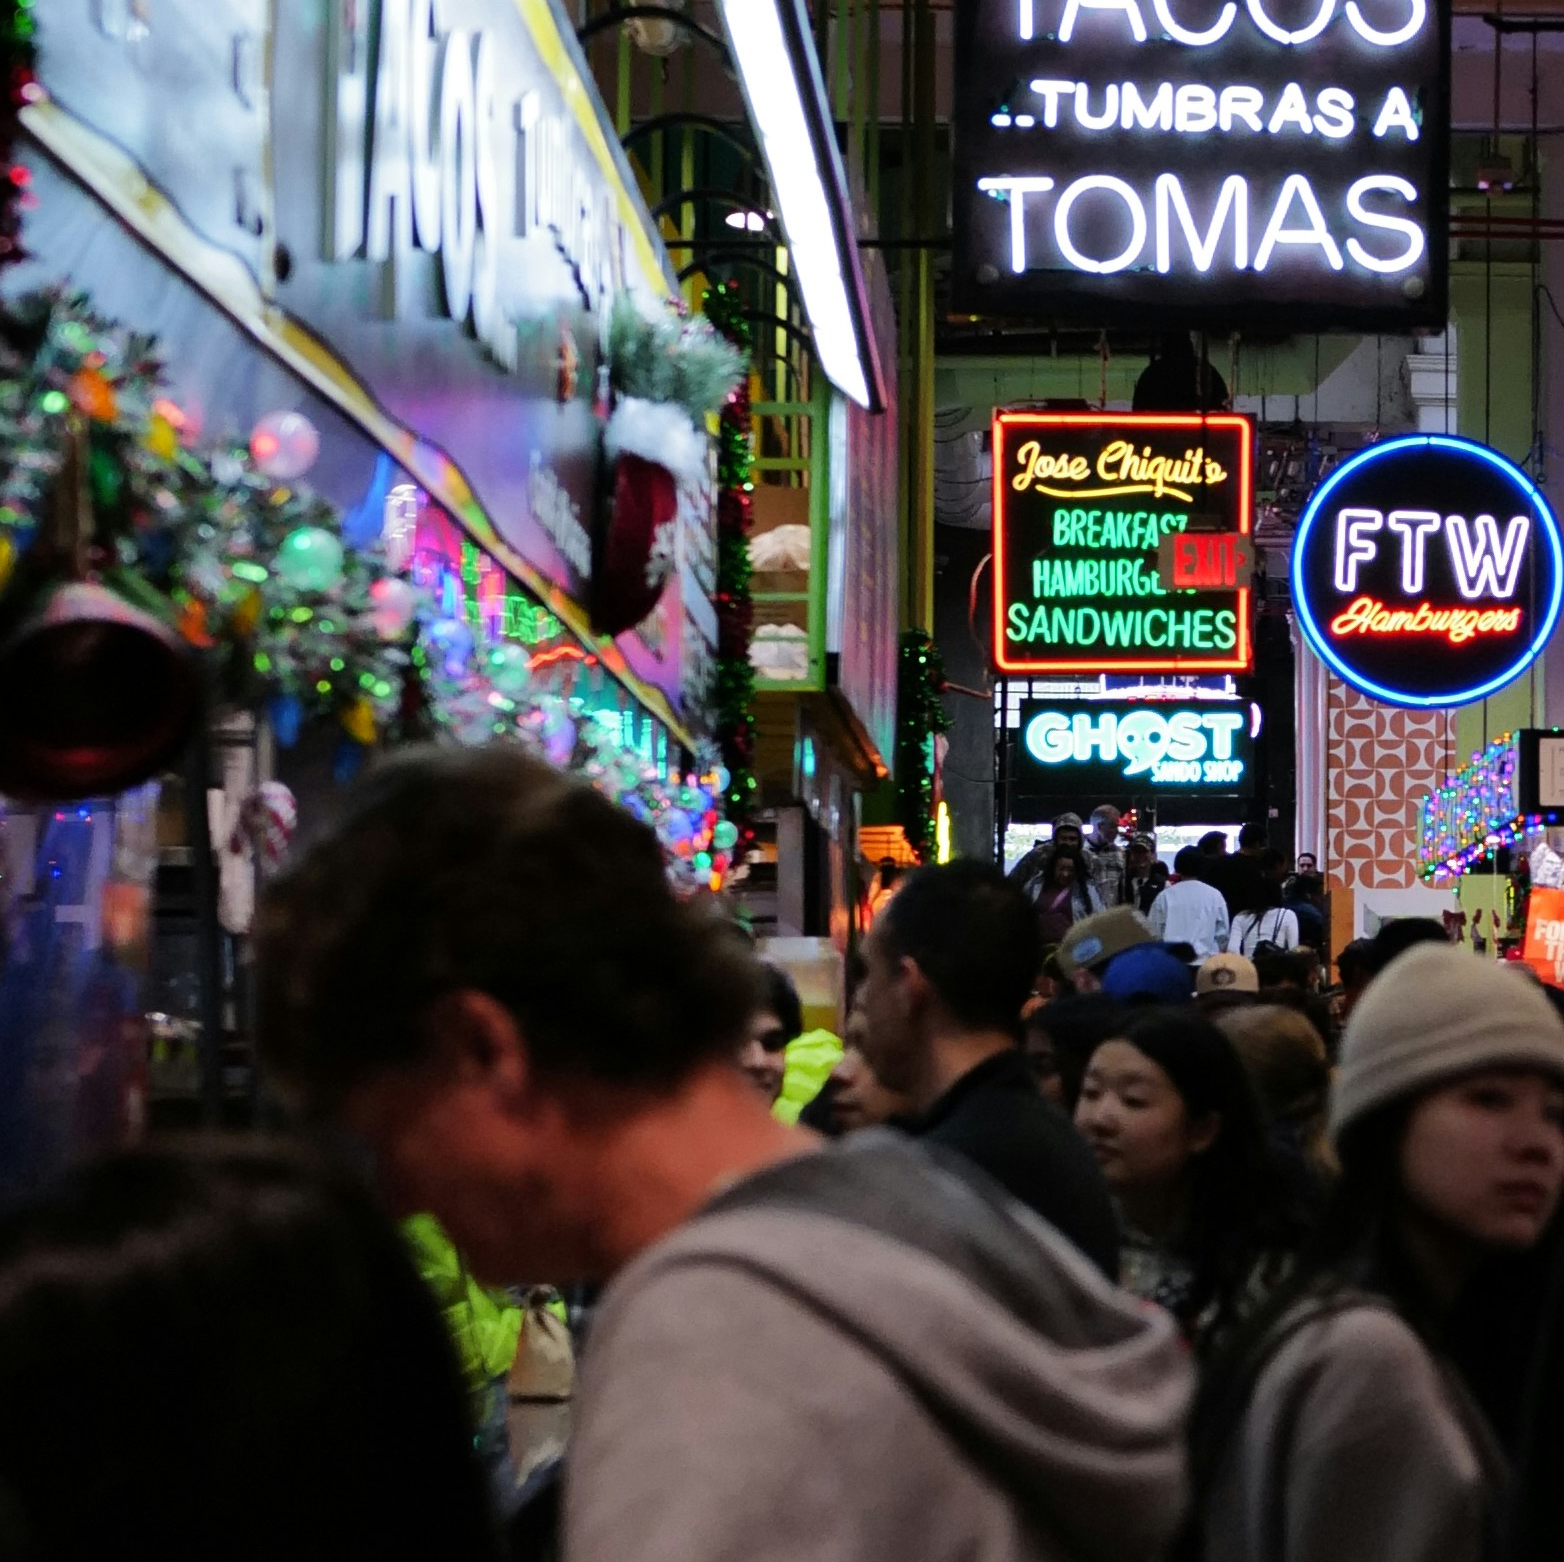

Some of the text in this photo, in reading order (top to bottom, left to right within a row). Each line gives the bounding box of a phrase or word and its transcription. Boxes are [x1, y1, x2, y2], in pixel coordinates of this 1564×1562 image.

[1372, 86, 1420, 141] A
[977, 172, 1425, 274] TOMAS
[1011, 440, 1091, 491] Jose
[1032, 558, 1197, 598] HAMBURG
[1173, 533, 1239, 587] EXIT
[1333, 508, 1530, 598] FTW
[1005, 602, 1237, 650] SANDWICHES
[1331, 597, 1521, 643] Hamburgers
[1026, 709, 1244, 774] GHOST
[1203, 760, 1244, 782] SHOP
